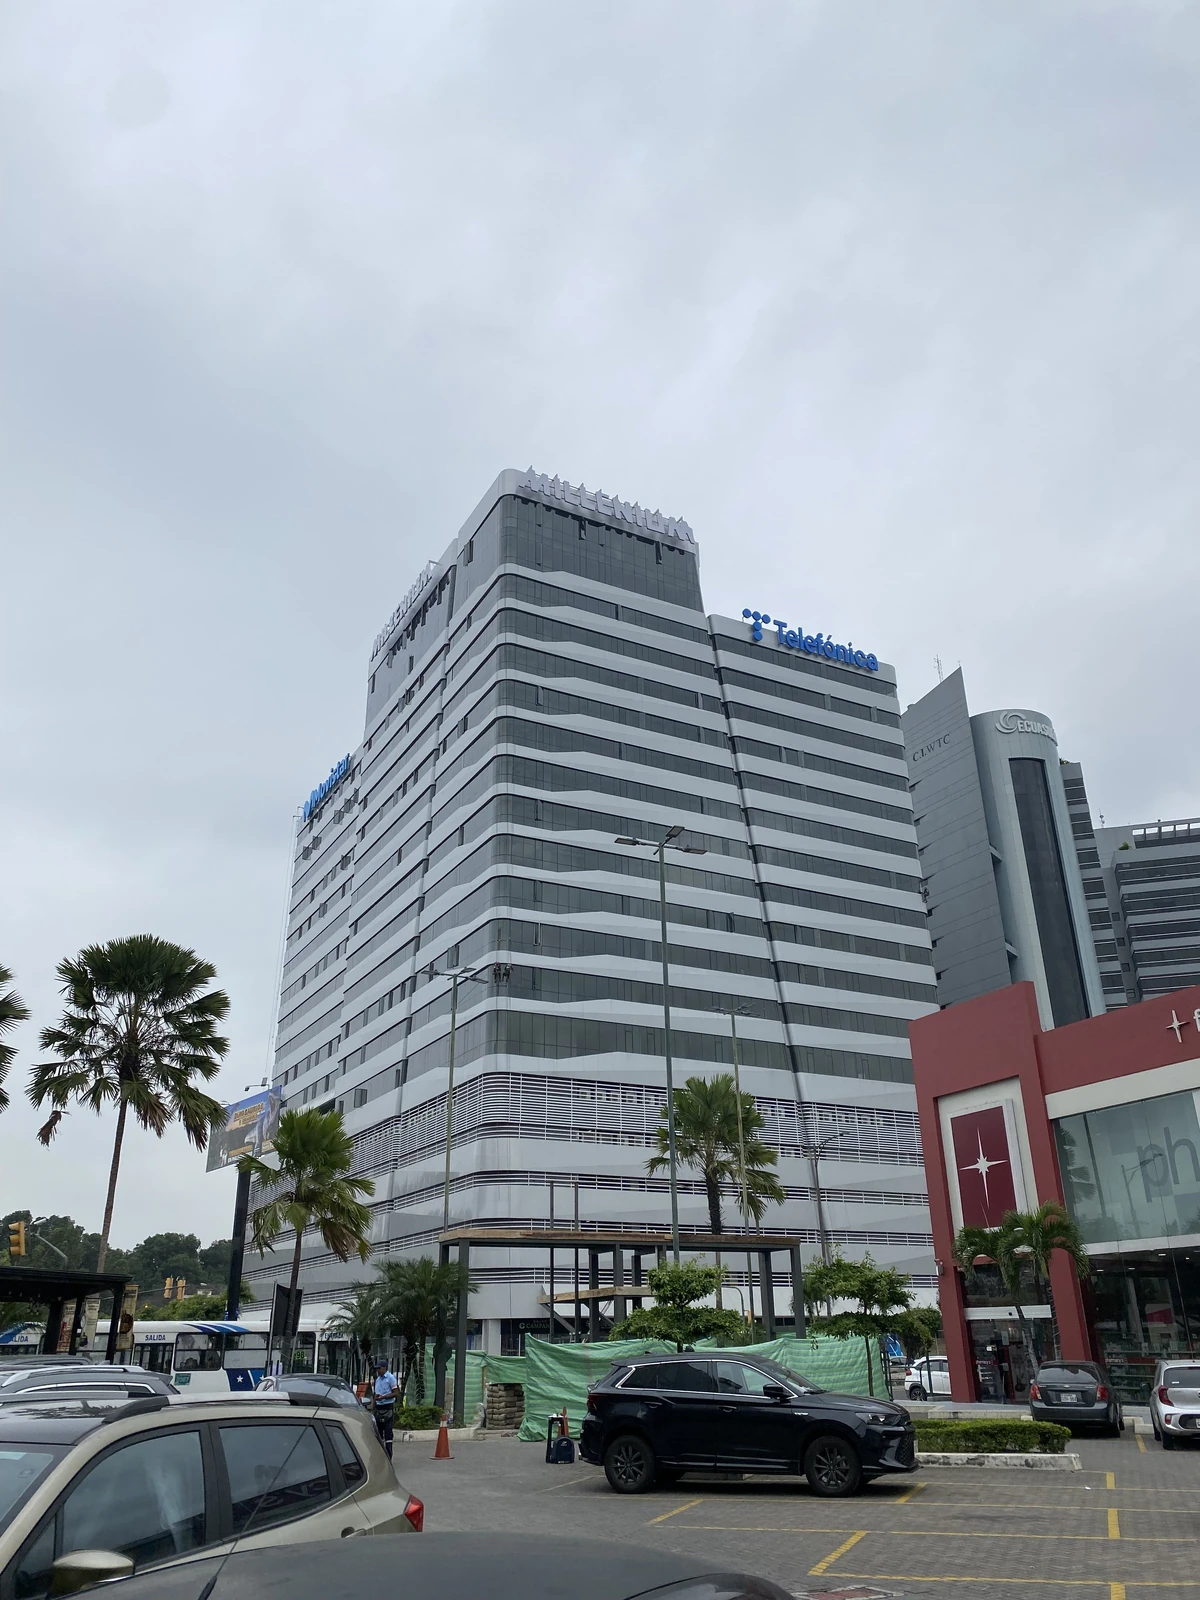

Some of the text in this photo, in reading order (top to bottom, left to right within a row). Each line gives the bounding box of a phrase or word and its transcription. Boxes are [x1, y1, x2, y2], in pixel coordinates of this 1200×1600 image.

[518, 465, 695, 545] MILLENIUM
[772, 618, 879, 673] Telefónica
[144, 1334, 166, 1342] SALIDA
